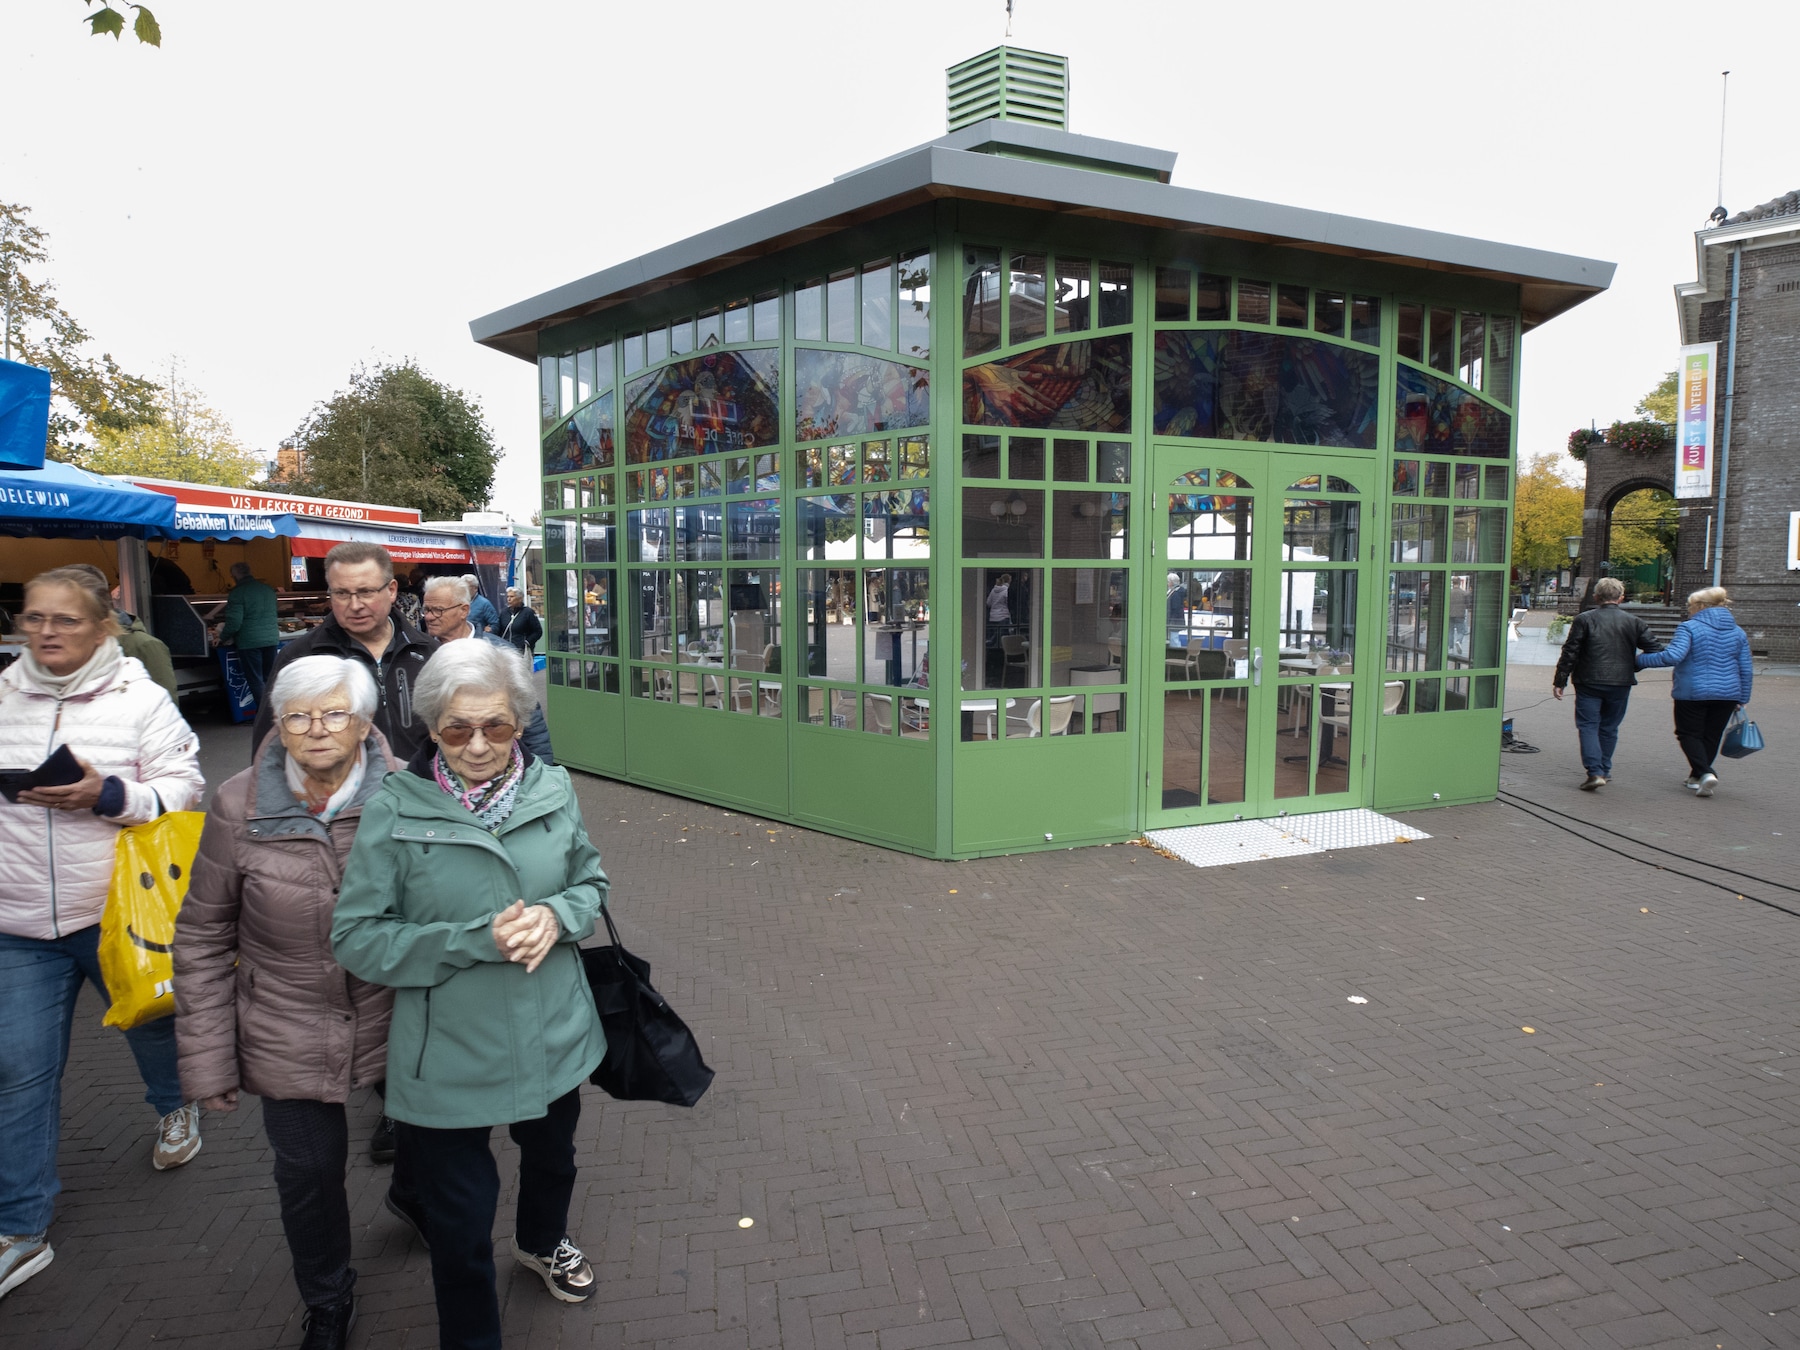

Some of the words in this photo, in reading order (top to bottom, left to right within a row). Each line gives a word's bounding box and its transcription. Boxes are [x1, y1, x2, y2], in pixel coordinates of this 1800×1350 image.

[1690, 360, 1703, 415] INTERIEUR
[1690, 418, 1700, 426] &
[1688, 432, 1700, 465] KUNST
[259, 499, 304, 514] LEKKER
[308, 504, 323, 516] EN
[326, 506, 363, 520] GEZOND
[174, 512, 227, 530] Gebakken
[227, 514, 276, 534] Kibbeling
